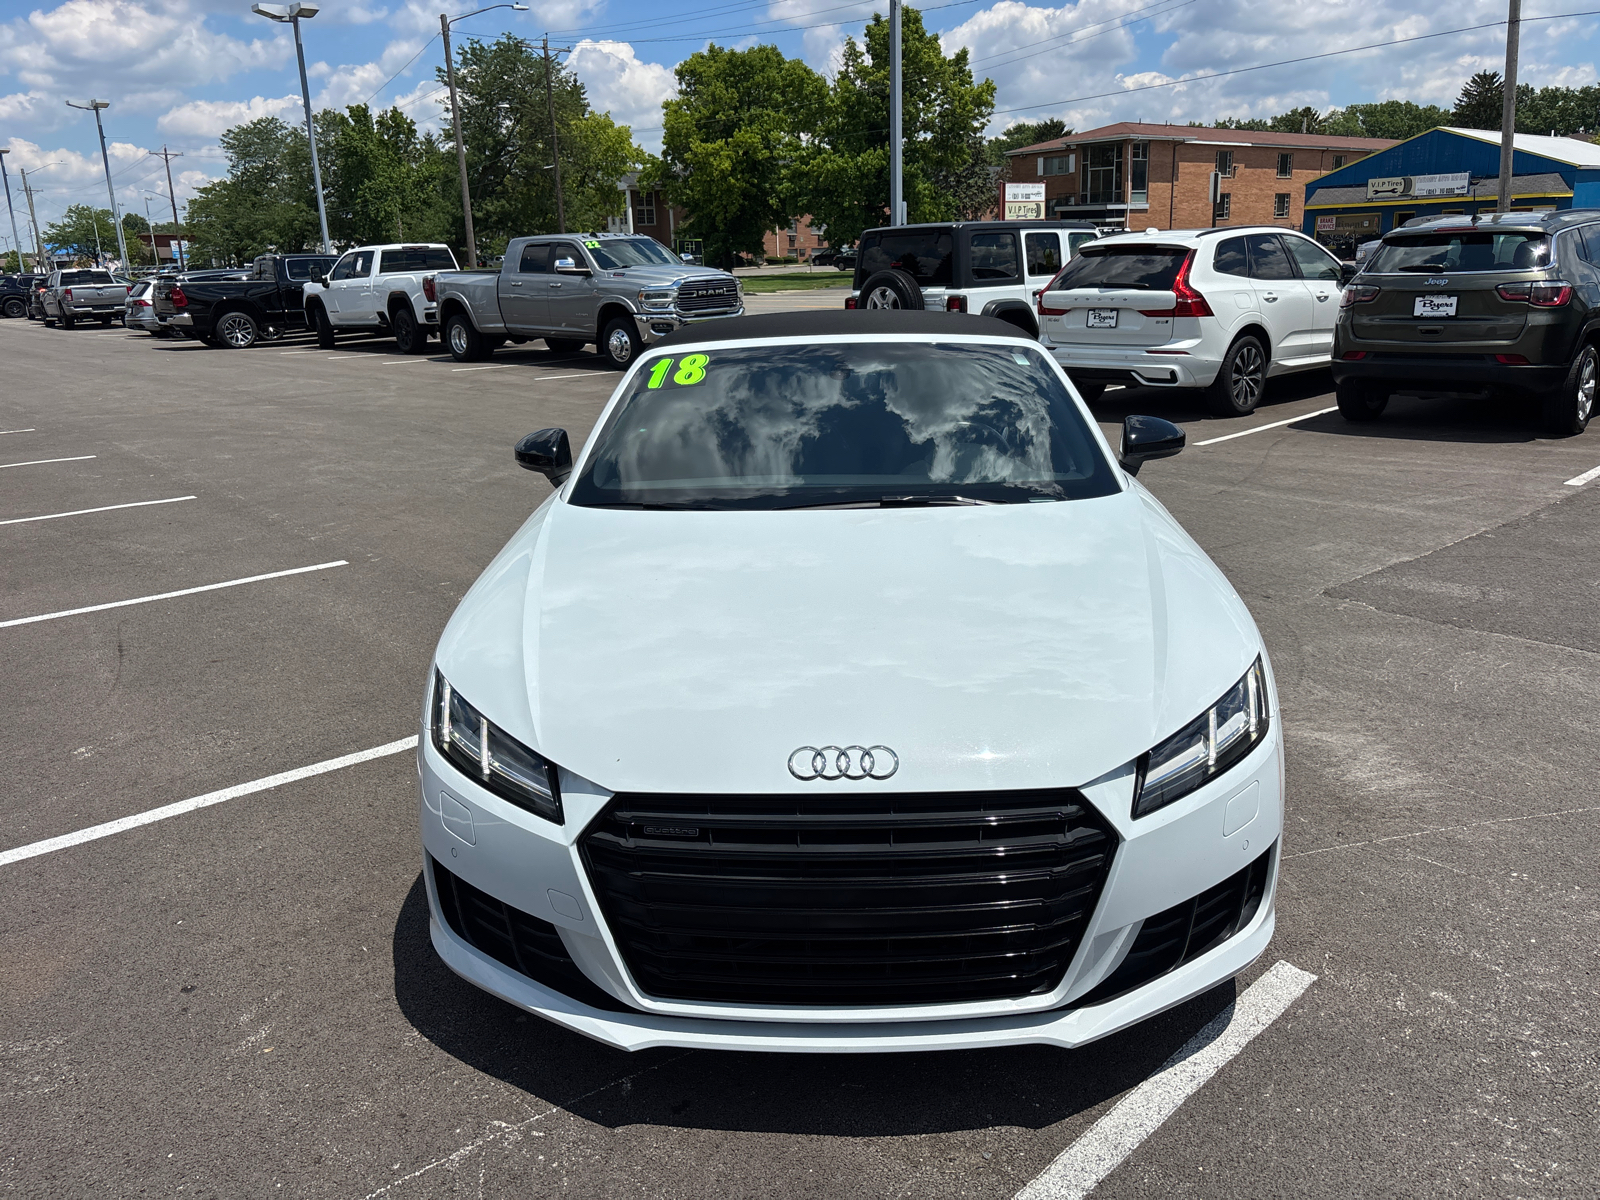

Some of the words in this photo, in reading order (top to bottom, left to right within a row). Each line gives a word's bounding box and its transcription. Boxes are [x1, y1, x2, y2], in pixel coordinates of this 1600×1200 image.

[1023, 205, 1037, 214] Tires
[585, 241, 601, 249] 22
[1424, 278, 1449, 286] Jeep
[699, 288, 724, 296] RAM
[1419, 299, 1453, 310] Byers
[1091, 312, 1115, 323] Byers
[647, 353, 710, 389] 18
[646, 827, 696, 835] quattro
